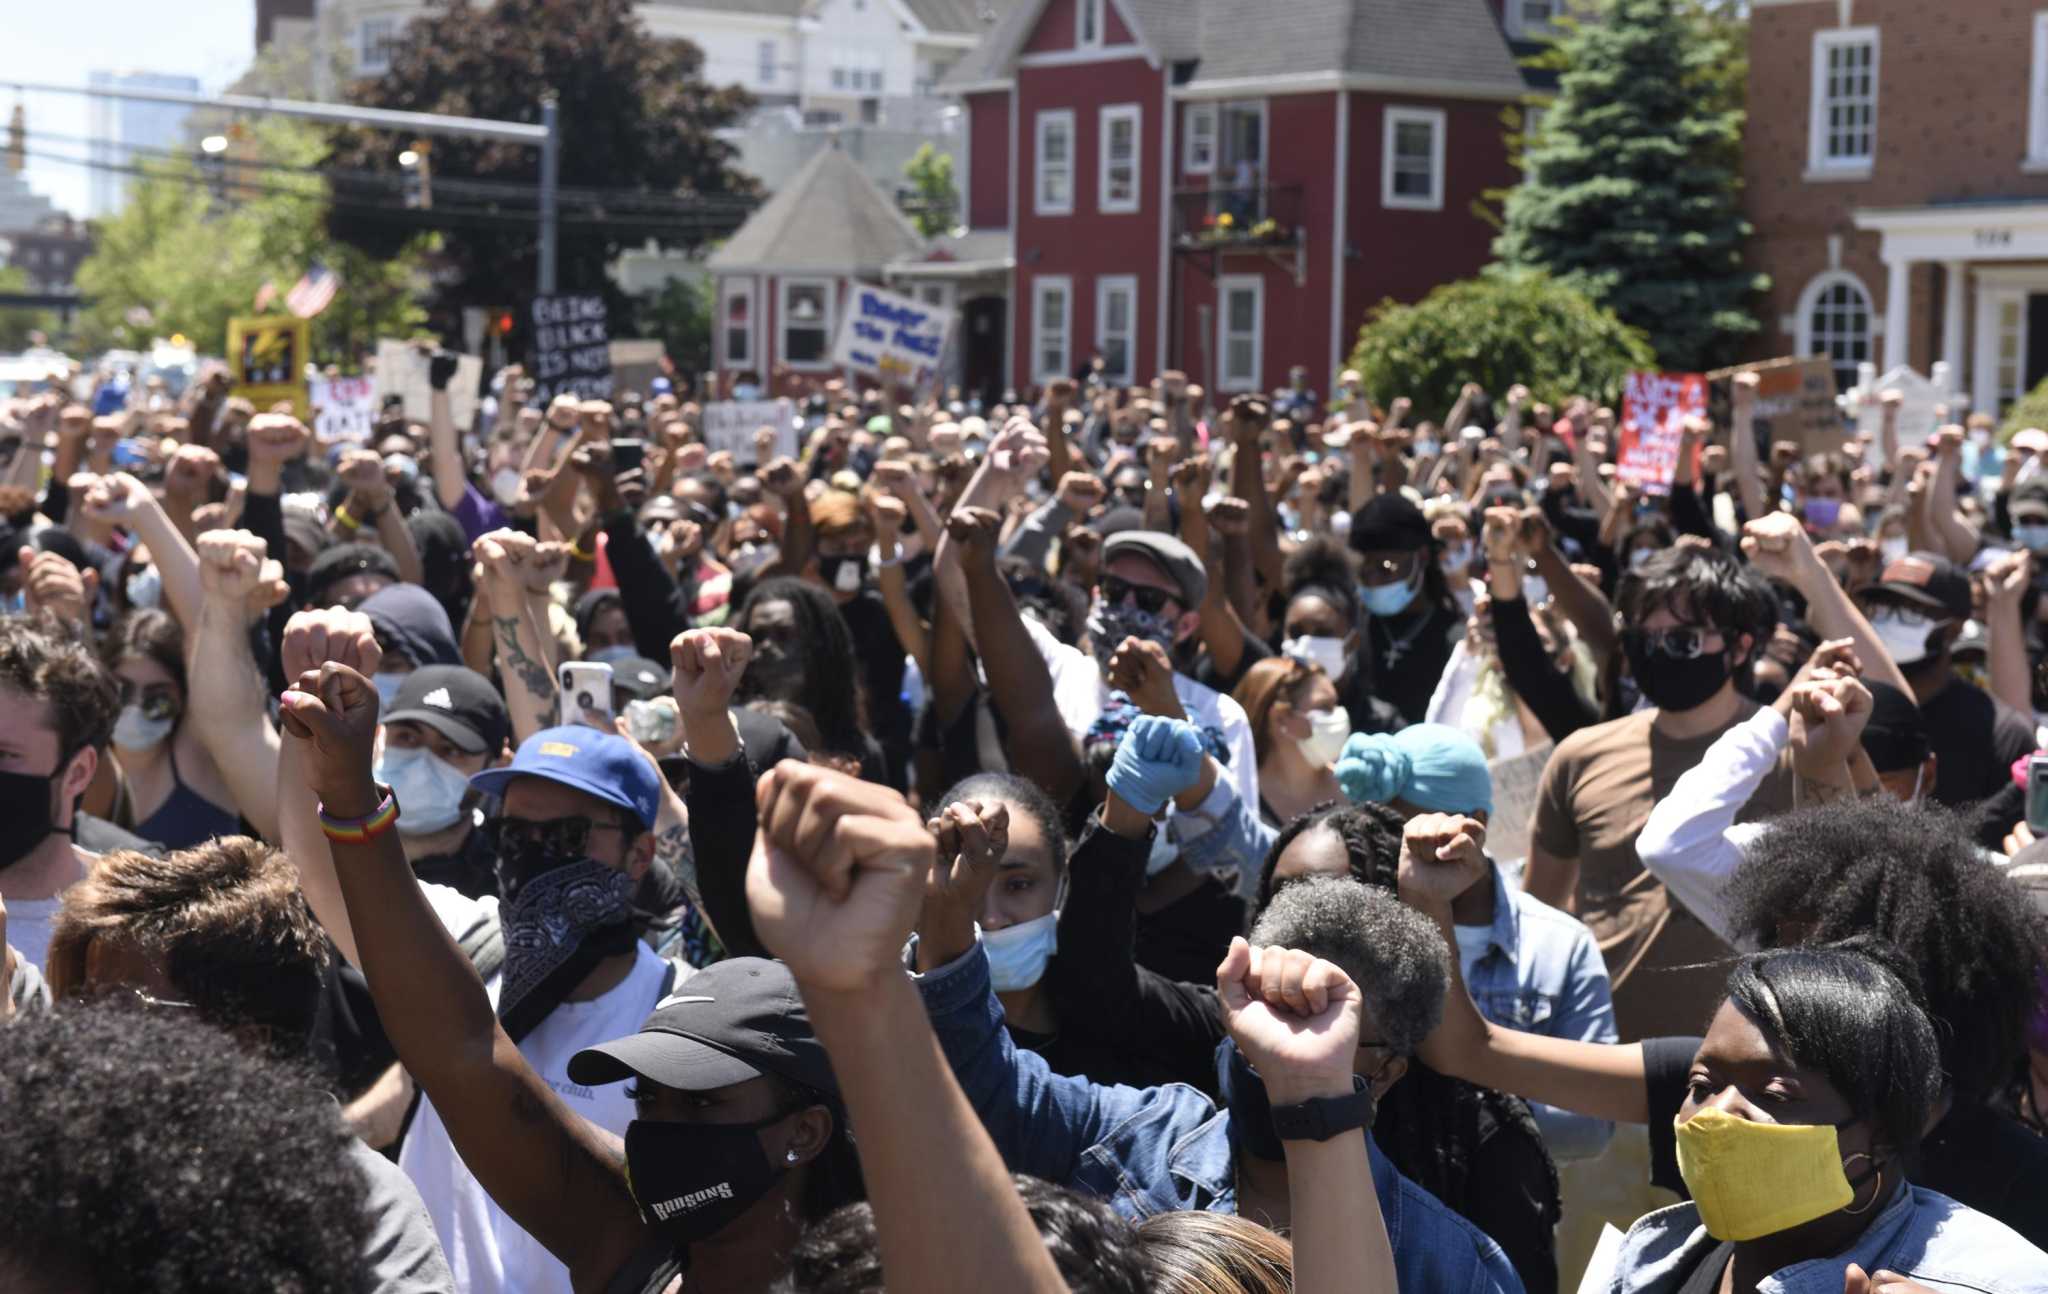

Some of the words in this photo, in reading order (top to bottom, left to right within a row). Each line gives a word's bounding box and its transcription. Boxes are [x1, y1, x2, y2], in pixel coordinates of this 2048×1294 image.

[532, 297, 606, 325] BEING
[538, 352, 567, 378] IS
[571, 347, 608, 371] NOT
